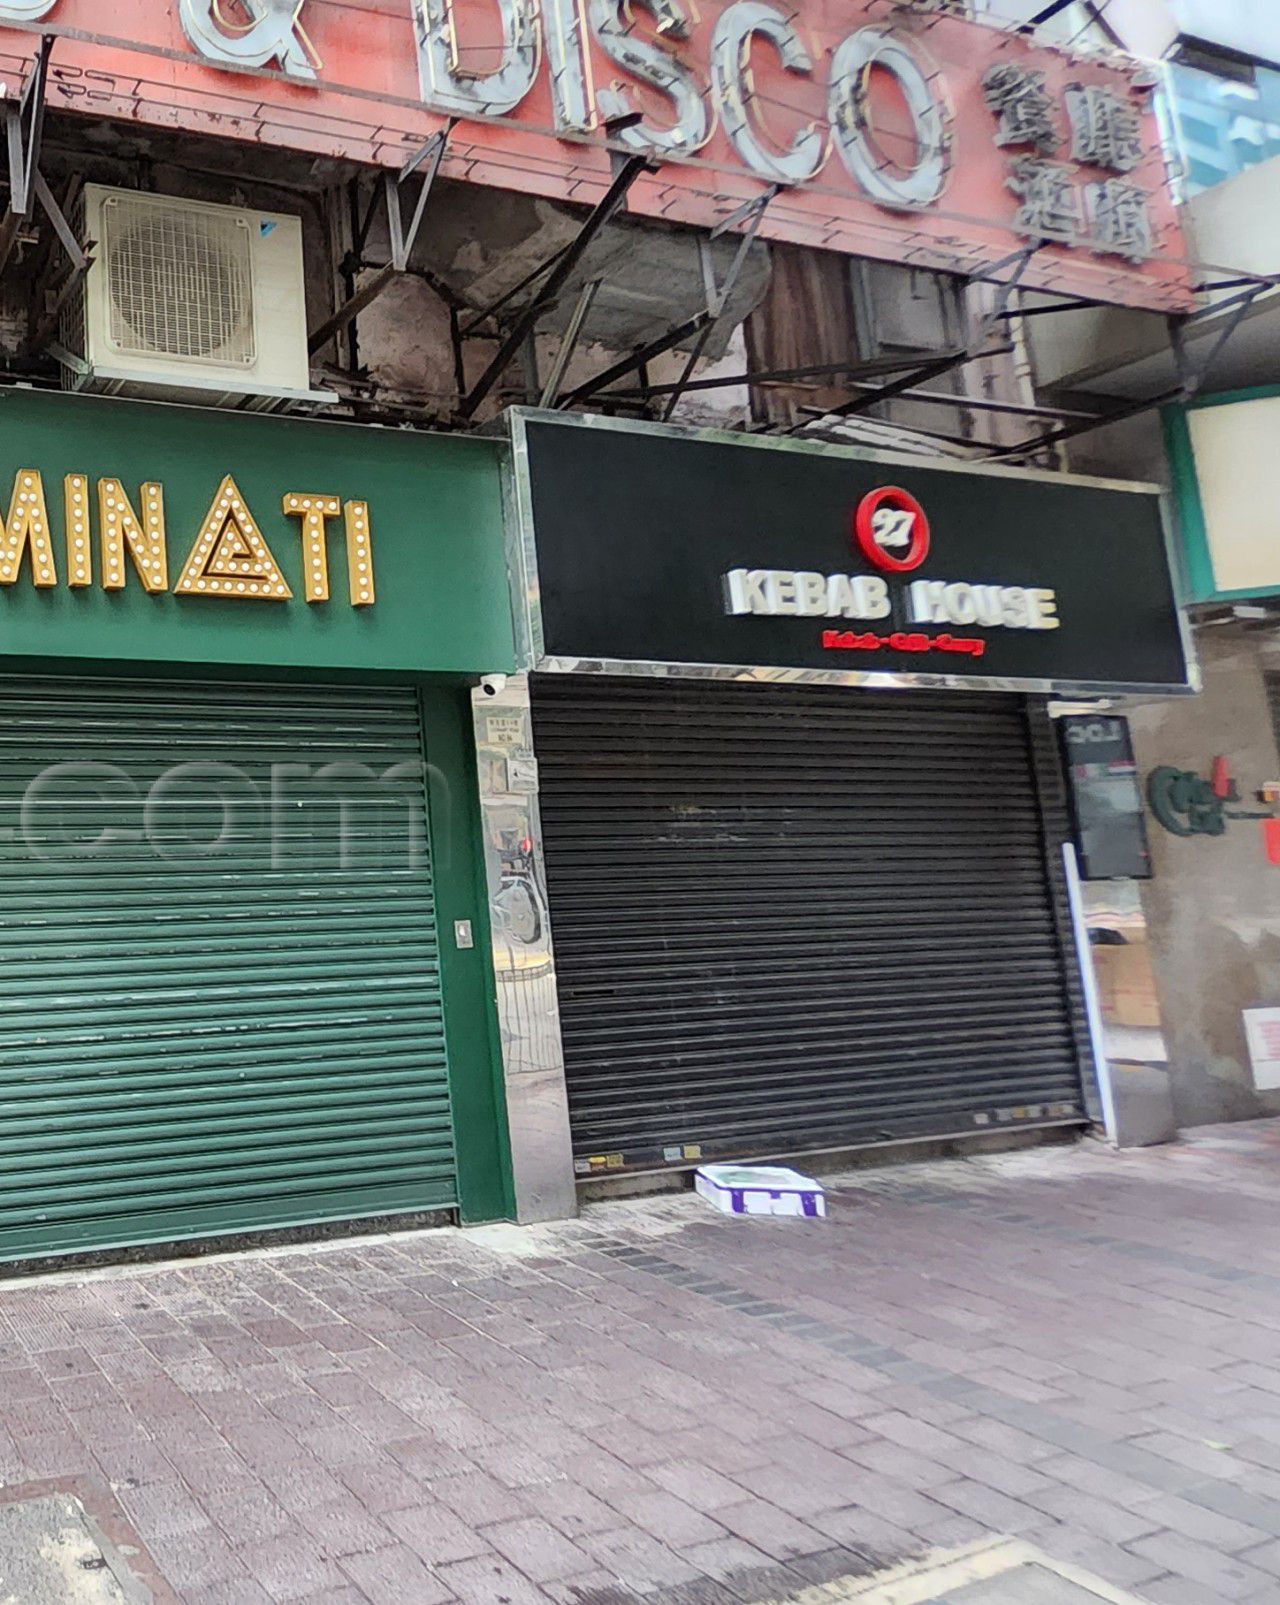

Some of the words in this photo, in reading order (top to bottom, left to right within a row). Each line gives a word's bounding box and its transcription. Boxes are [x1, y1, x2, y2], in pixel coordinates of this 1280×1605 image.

[872, 507, 918, 548] 27
[724, 568, 893, 620] KEBAB
[907, 579, 1061, 630] HOUSE
